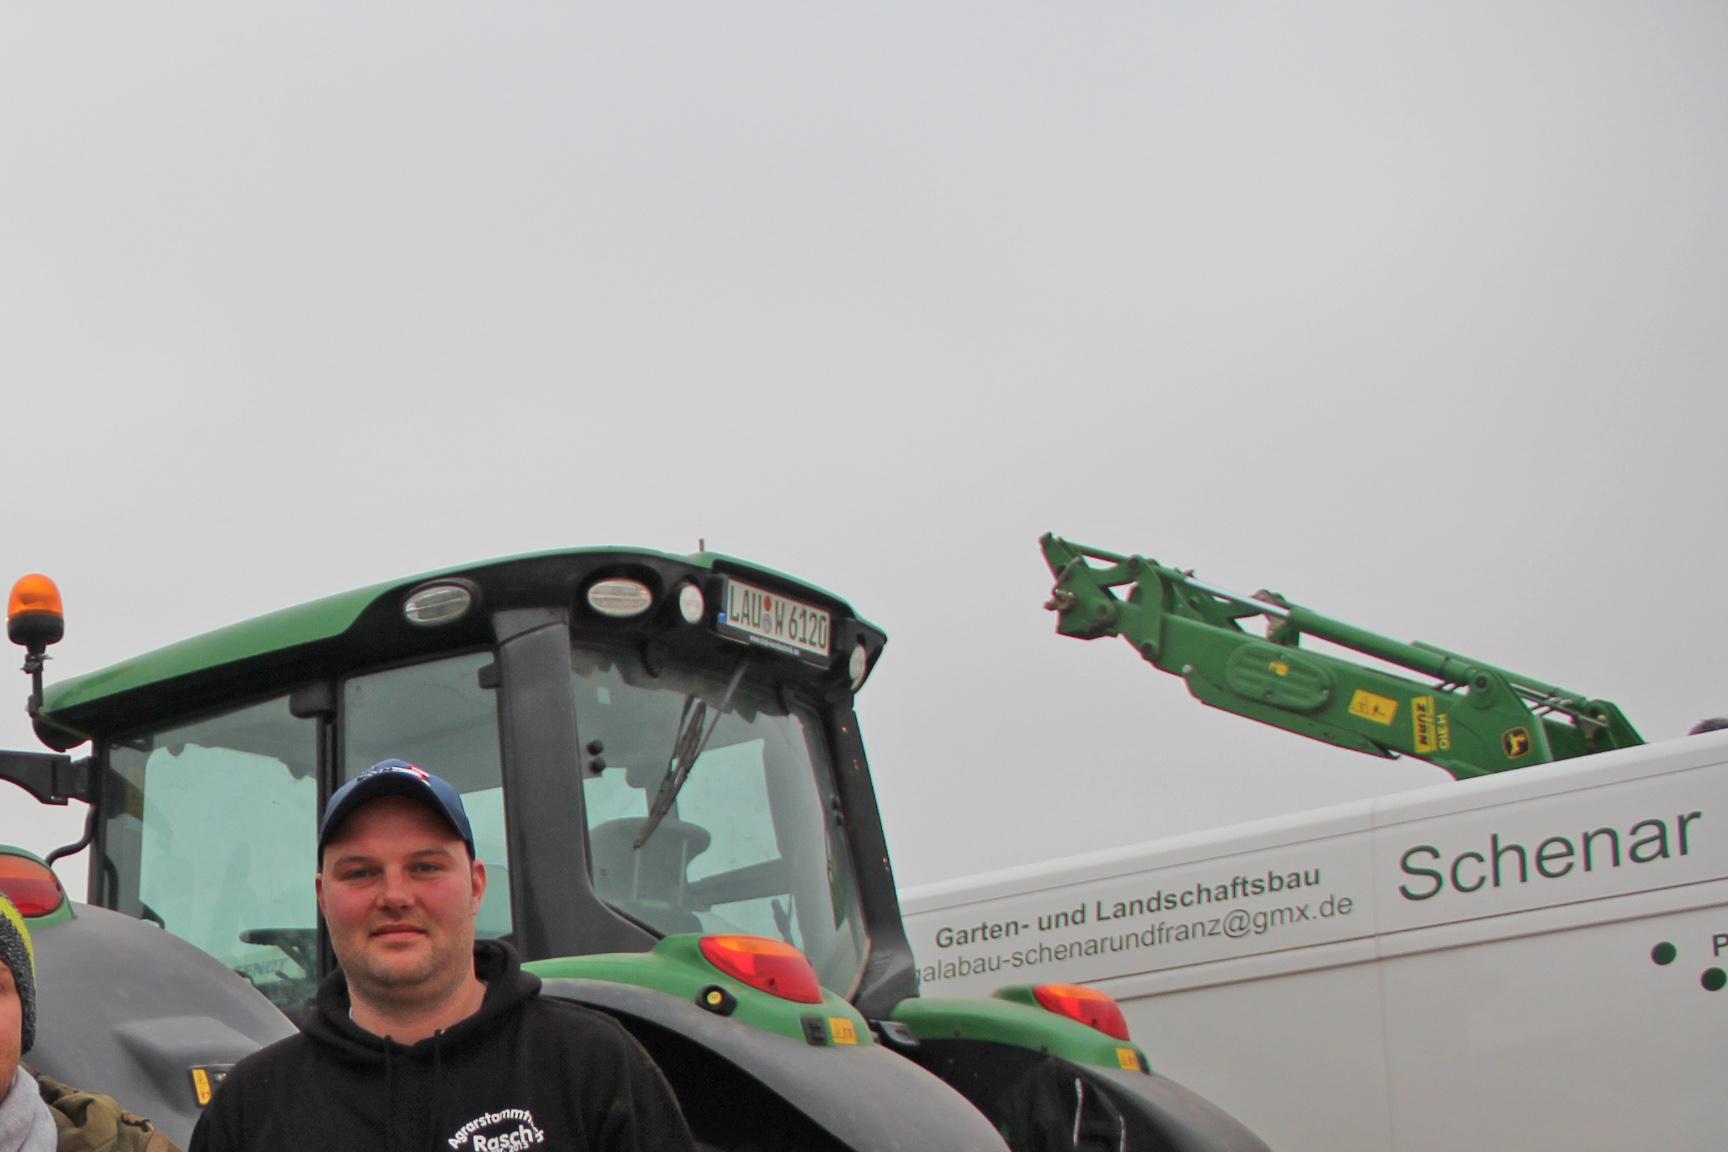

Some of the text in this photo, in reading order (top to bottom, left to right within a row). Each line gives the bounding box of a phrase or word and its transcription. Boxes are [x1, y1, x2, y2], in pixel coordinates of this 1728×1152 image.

[729, 585, 762, 629] LAU
[775, 600, 785, 637] W
[788, 606, 828, 649] 6120
[1398, 810, 1702, 901] Schenar
[936, 867, 1321, 948] Garten- und Landschaftsbau
[473, 1125, 533, 1152] Rasch
